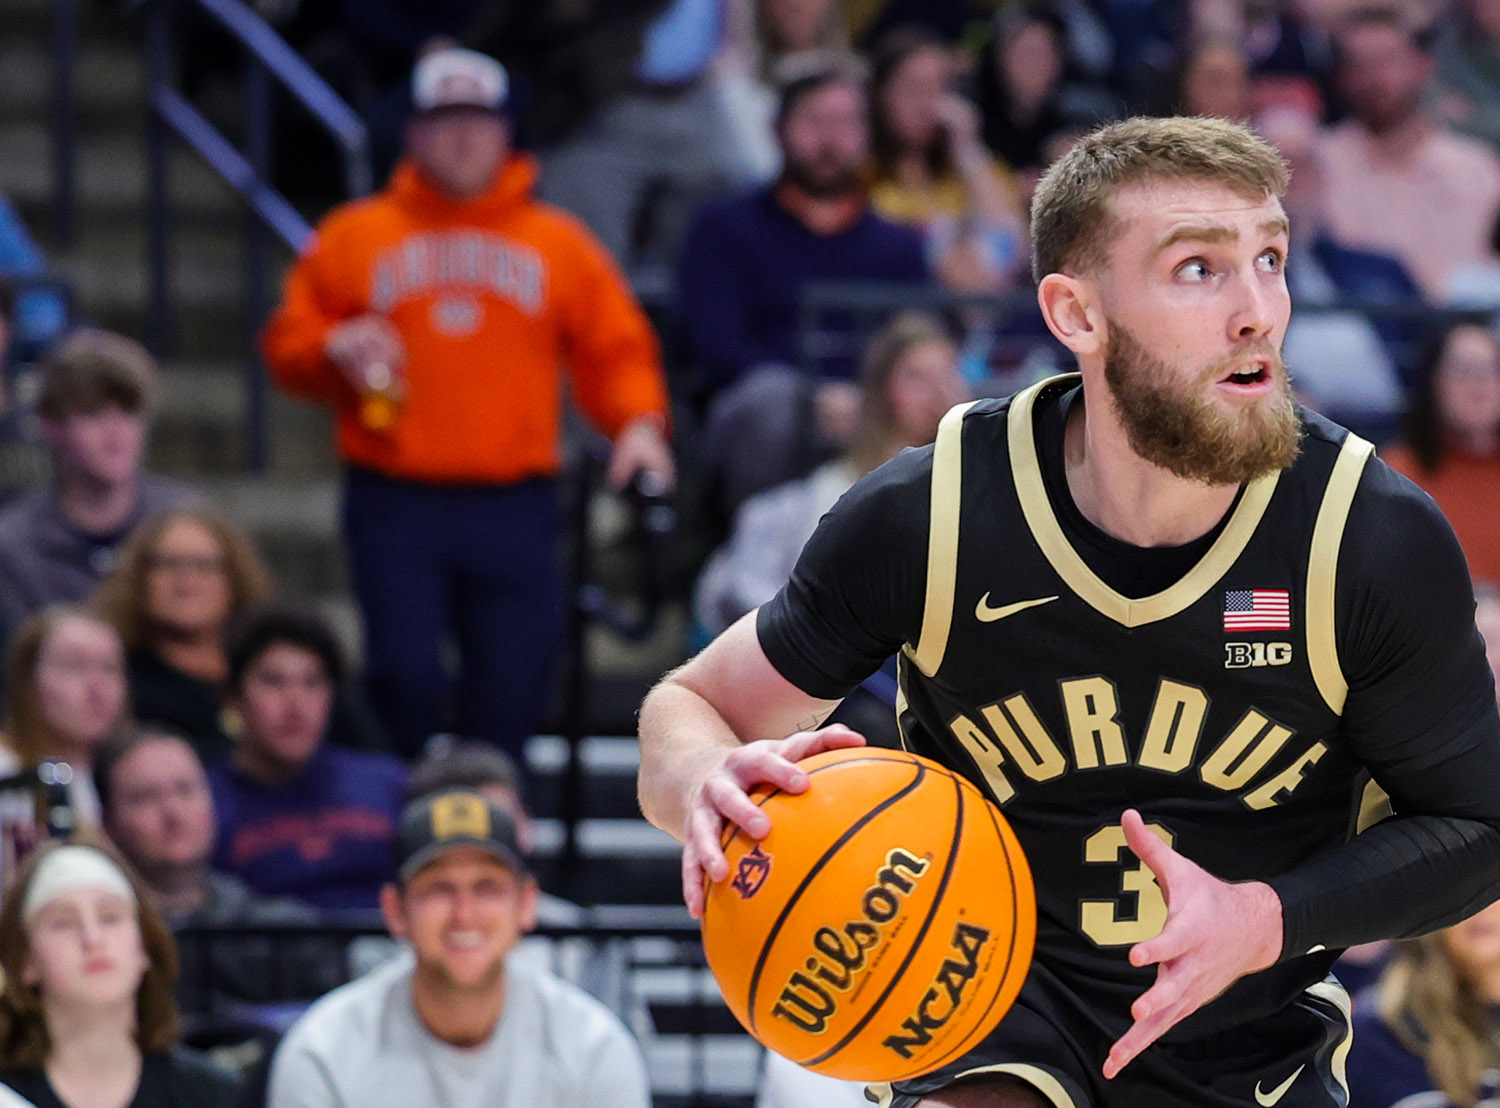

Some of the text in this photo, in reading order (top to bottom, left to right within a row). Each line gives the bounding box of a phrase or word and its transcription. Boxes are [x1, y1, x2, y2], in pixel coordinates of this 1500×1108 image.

[949, 675, 1330, 811] PURDUE
[771, 847, 932, 1035] Wilson
[1080, 822, 1177, 946] 3
[881, 920, 993, 1059] NCAA
